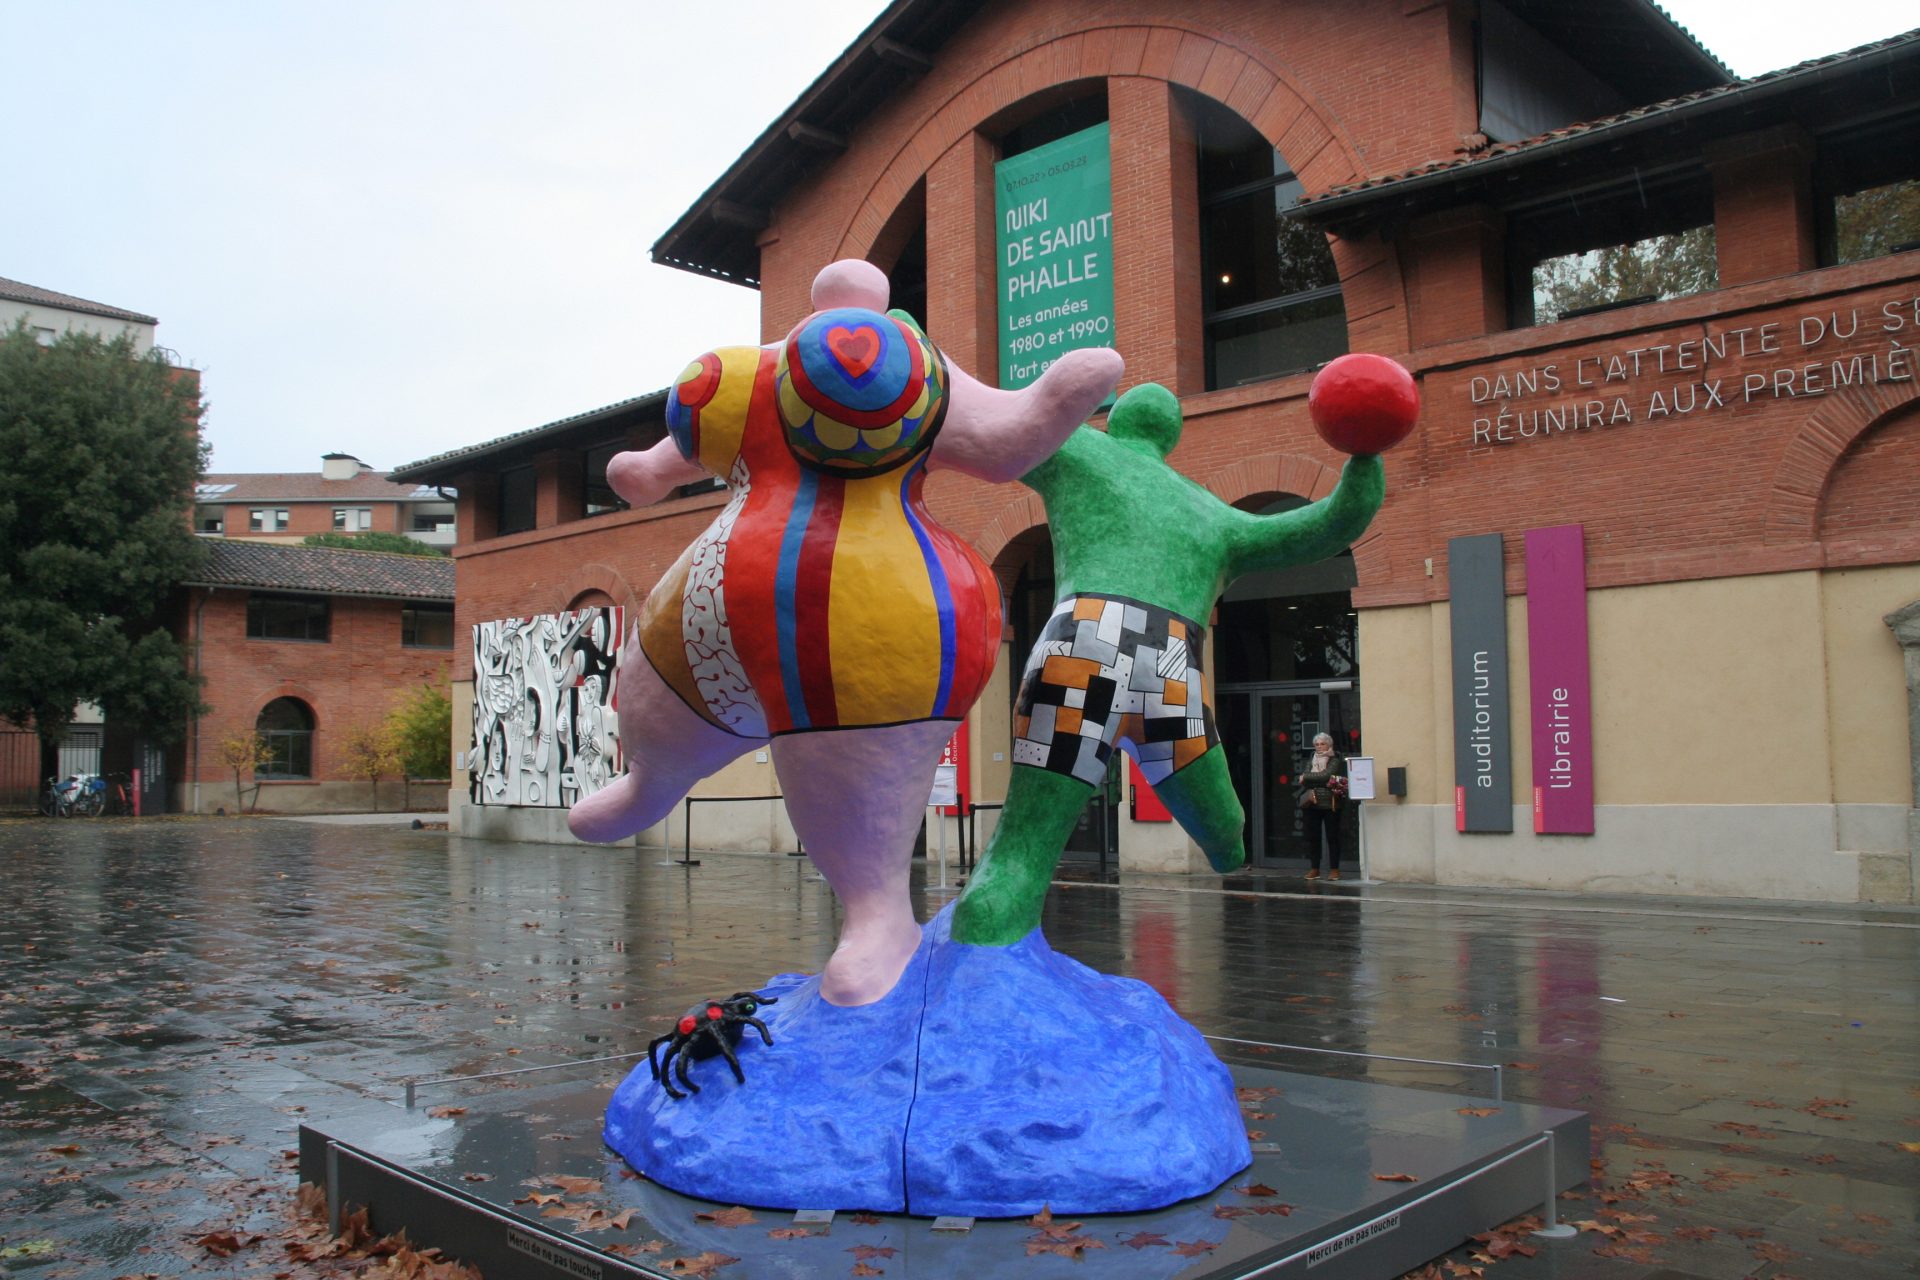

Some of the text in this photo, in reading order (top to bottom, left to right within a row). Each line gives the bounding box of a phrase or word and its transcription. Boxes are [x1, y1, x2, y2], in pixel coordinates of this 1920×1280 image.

[1006, 197, 1047, 234] NIKI
[1007, 211, 1112, 267] DE SAINT
[1008, 252, 1098, 302] PHALLE
[1009, 298, 1088, 331] Les années
[1009, 332, 1045, 356] 1980
[1048, 327, 1064, 345] et
[1067, 316, 1109, 340] 1990
[1009, 360, 1038, 381] l'art
[1471, 365, 1560, 403] DANS
[1577, 322, 1781, 385] L'ATTENTE
[1800, 309, 1857, 346] DU
[1473, 340, 1911, 444] RÉUNIRA AUX PREMIÈ
[1469, 651, 1492, 788] auditorium
[1548, 687, 1572, 789] librairie
[508, 1231, 601, 1280] Merci de ne pas toucher
[1308, 1215, 1399, 1264] Merci de ne pas toucher
